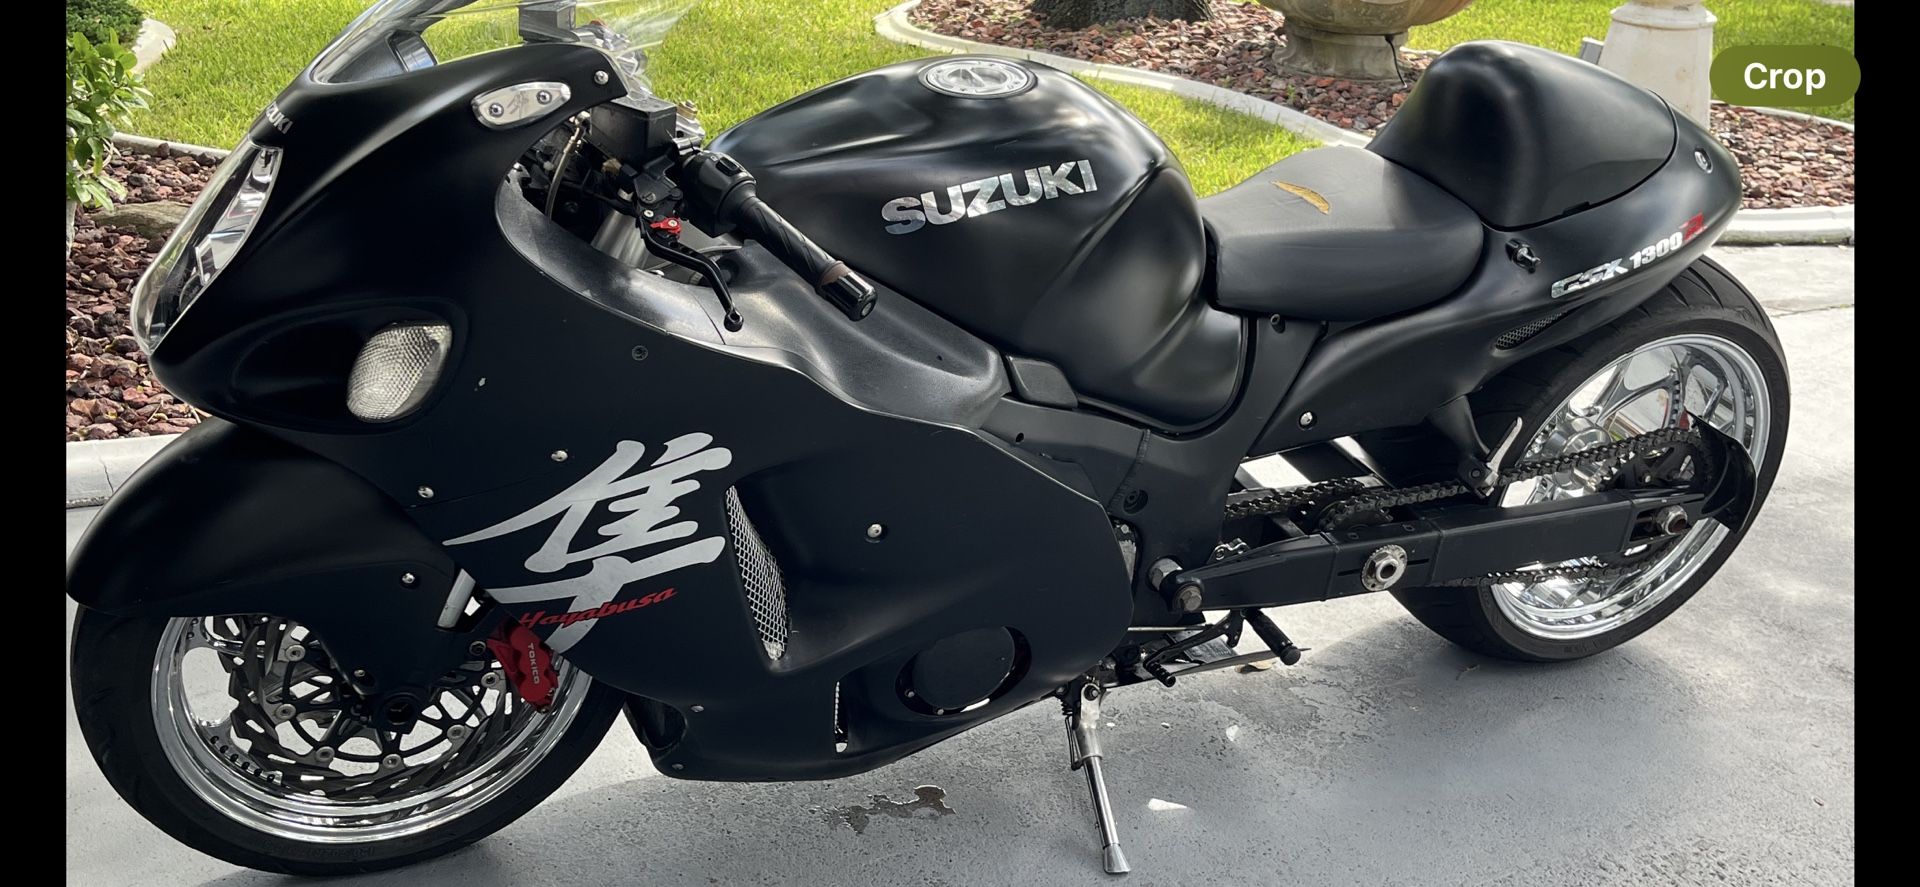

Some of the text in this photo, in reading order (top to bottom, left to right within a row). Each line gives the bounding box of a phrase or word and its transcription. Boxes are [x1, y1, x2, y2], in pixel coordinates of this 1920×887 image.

[881, 159, 1098, 235] SUZUKI
[518, 587, 679, 629] Hayabusa
[527, 642, 540, 685] TOKICO
